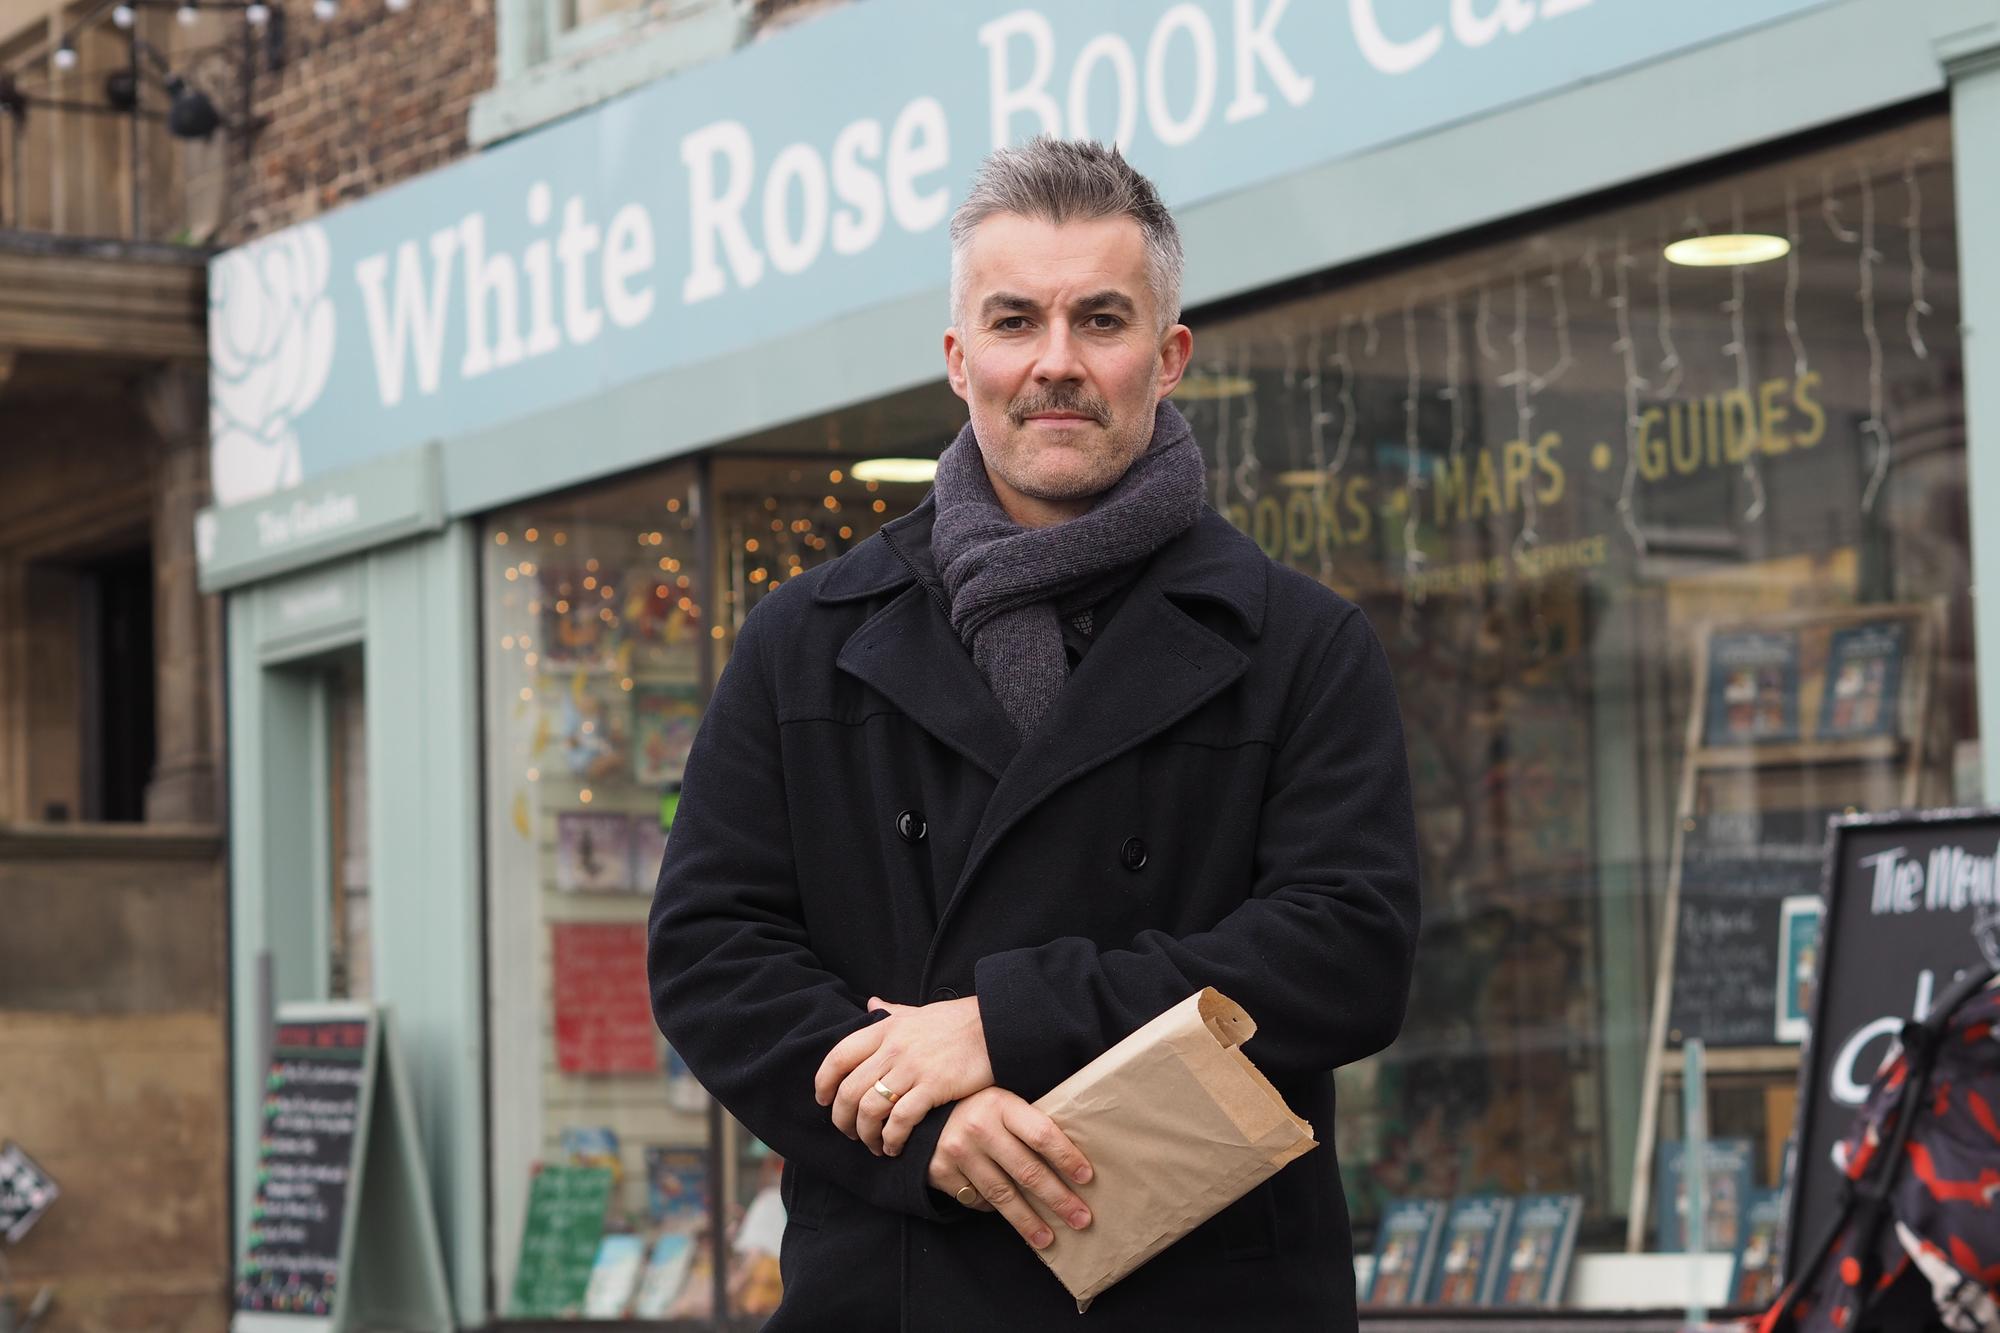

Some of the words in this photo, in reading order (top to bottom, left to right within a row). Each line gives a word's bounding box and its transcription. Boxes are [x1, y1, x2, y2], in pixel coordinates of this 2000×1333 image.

[354, 181, 656, 407] White
[681, 97, 949, 305] Rose
[1434, 431, 1566, 527] MAPS
[1637, 371, 1826, 482] GUIDES
